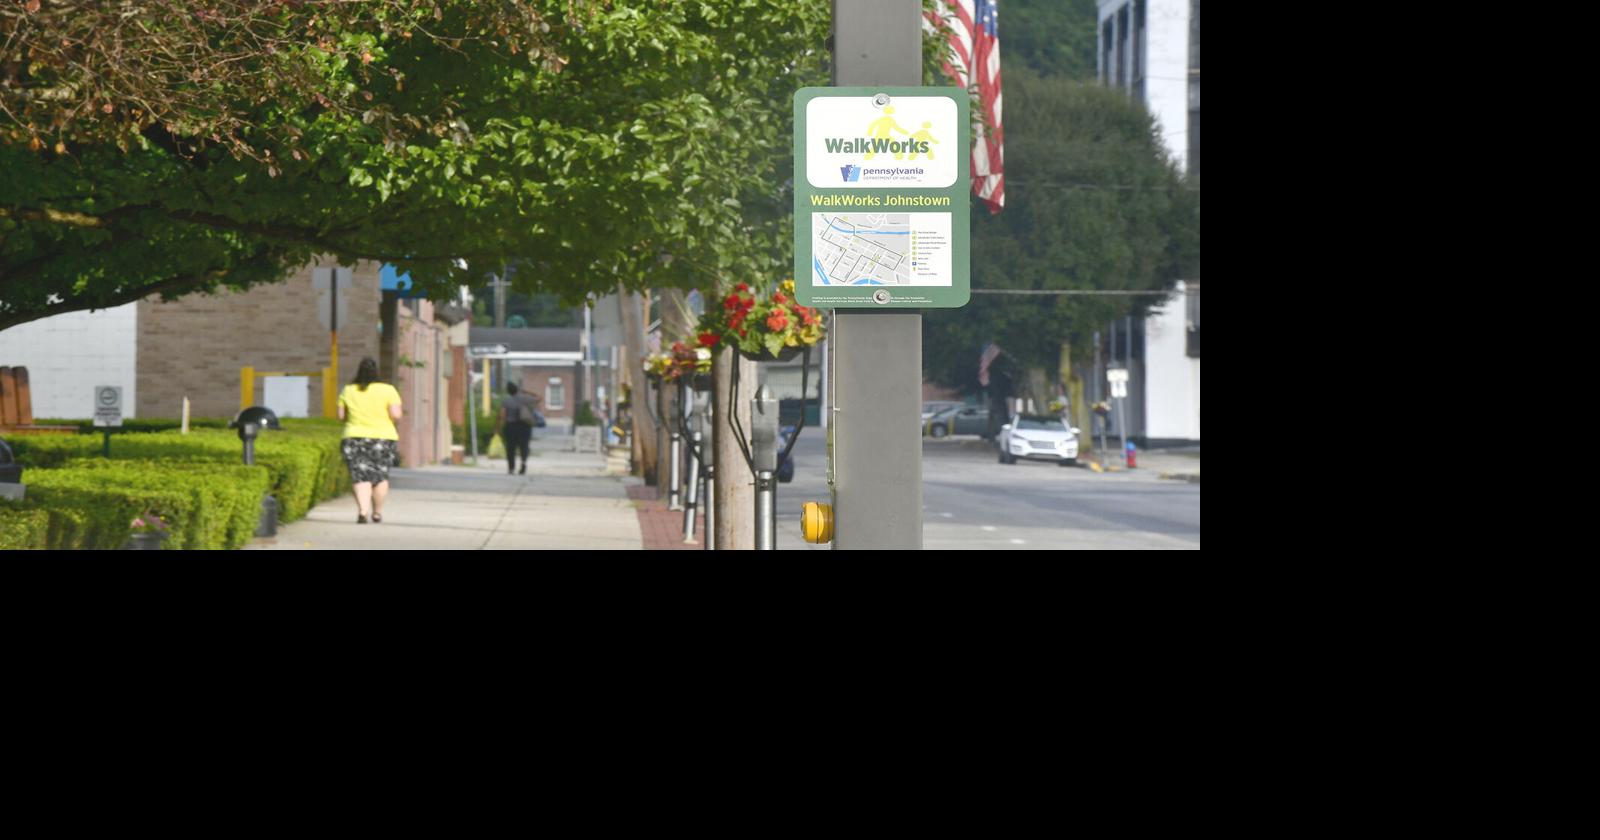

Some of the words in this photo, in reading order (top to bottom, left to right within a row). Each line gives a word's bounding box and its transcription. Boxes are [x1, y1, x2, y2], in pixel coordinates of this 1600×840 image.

[825, 138, 929, 153] WalkWorks
[863, 167, 924, 176] pennsylvania
[810, 195, 880, 206] WalkWorks
[884, 195, 950, 206] Johnstown
